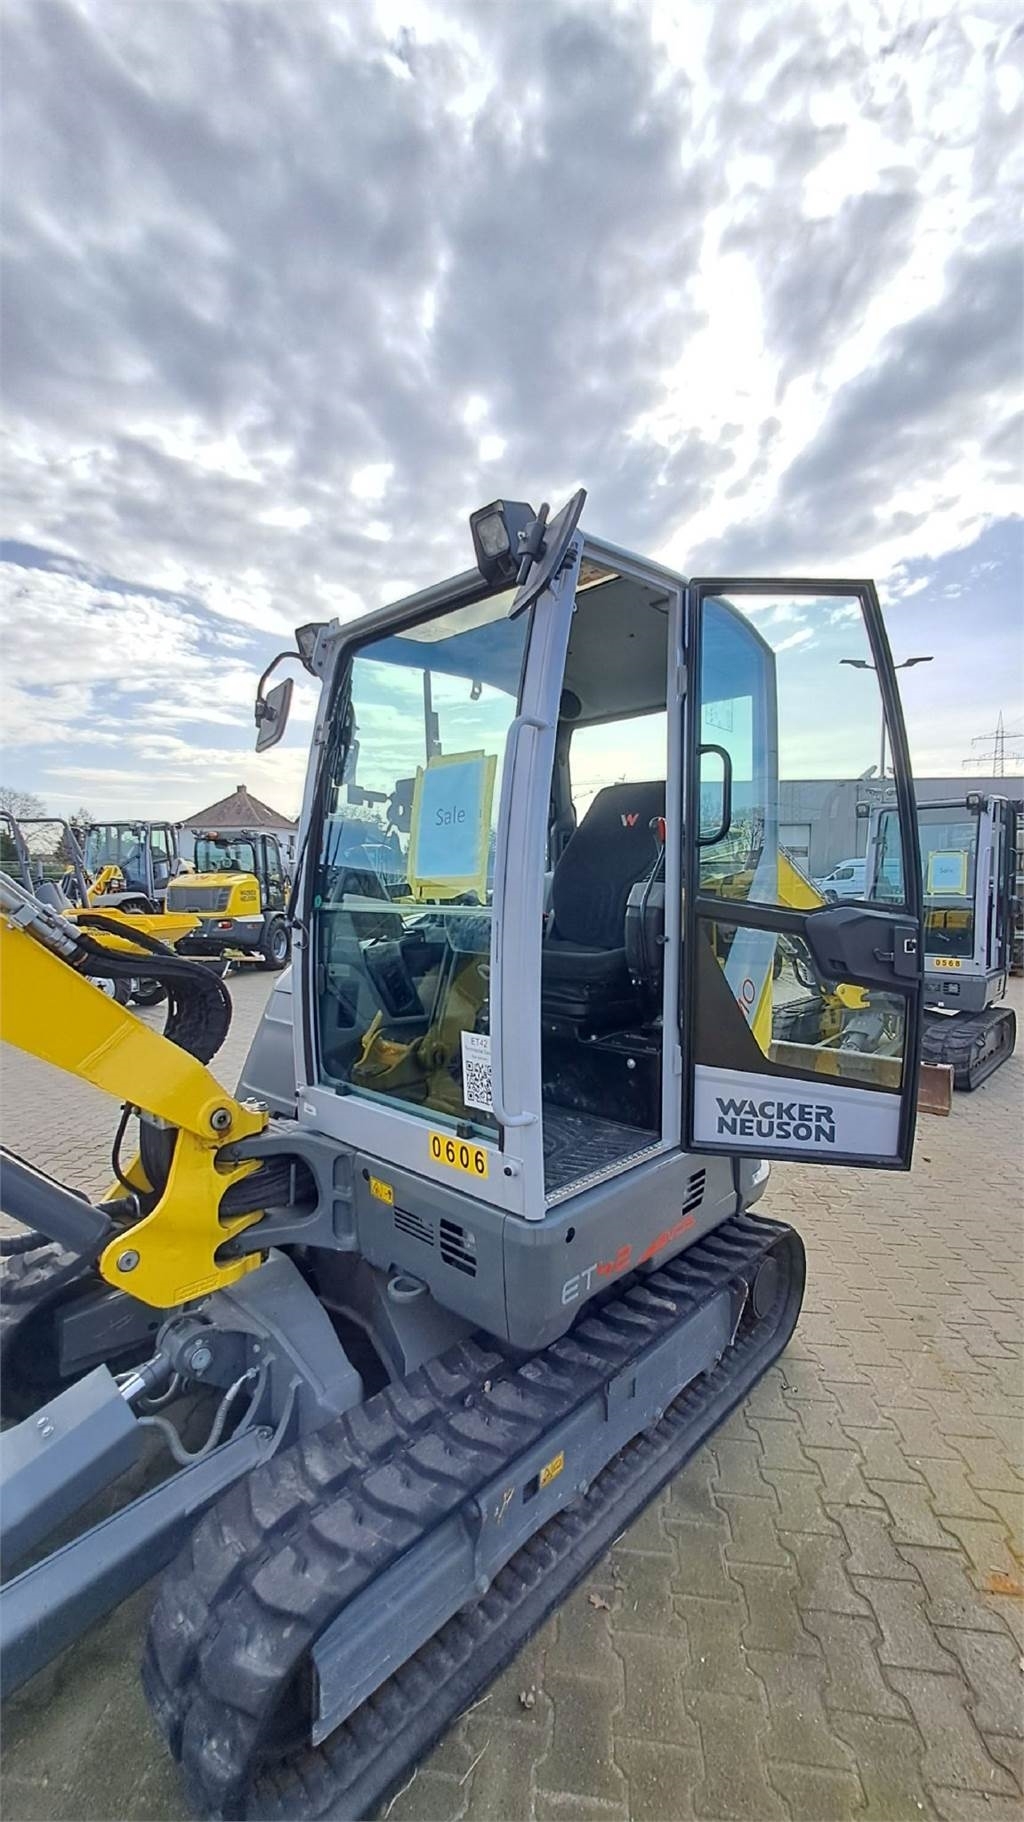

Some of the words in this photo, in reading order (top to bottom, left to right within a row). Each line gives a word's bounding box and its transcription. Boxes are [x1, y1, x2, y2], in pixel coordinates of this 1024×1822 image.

[435, 805, 465, 826] Sale
[715, 1097, 835, 1124] WACKER
[717, 1116, 835, 1143] NEUSON
[432, 1135, 485, 1174] 0606
